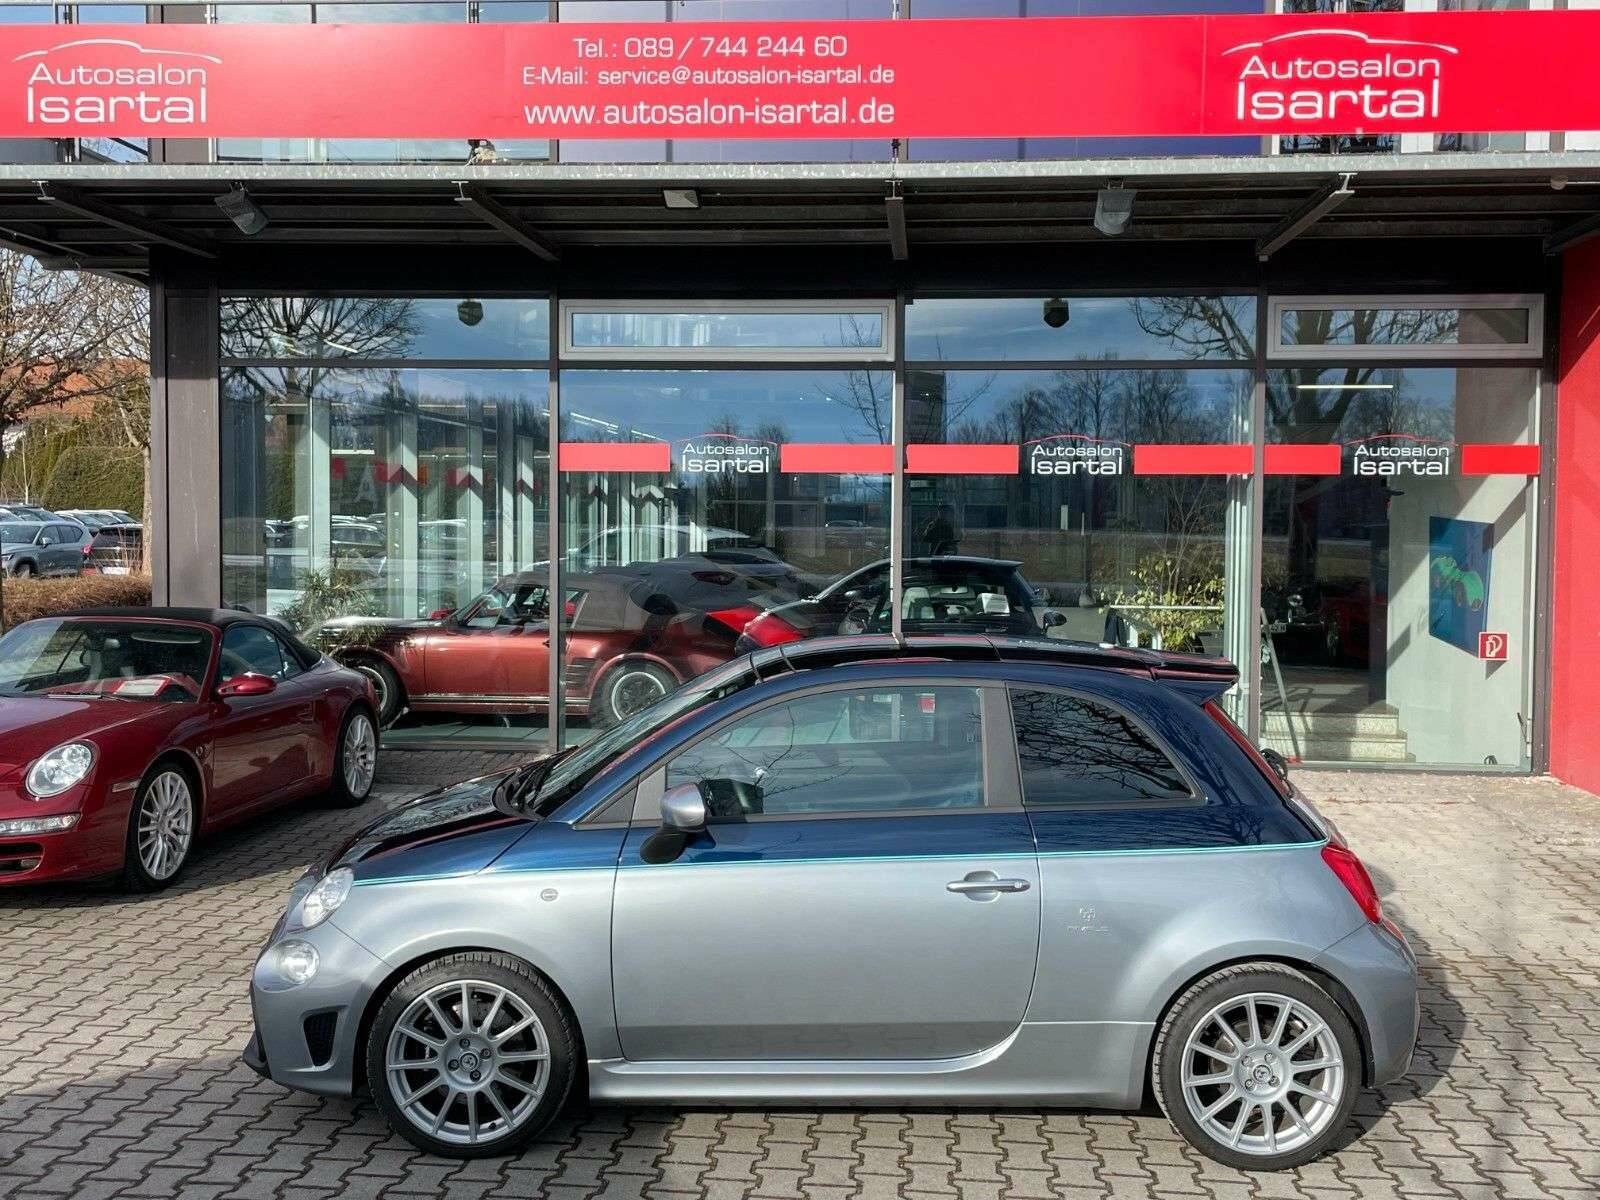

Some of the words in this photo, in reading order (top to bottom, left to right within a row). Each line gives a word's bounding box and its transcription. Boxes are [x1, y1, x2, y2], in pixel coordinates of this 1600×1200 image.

[573, 37, 618, 58] Tel.:
[624, 37, 674, 57] 089
[677, 37, 694, 60] /
[700, 37, 748, 57] 744
[757, 36, 805, 57] 244
[814, 35, 848, 57] 60
[28, 62, 207, 86] Autosalon
[522, 66, 589, 85] E-Mail:
[598, 64, 895, 85] service@autosalon-isartal.de
[1239, 53, 1441, 80] Autosalon
[27, 86, 207, 123] Isartal
[1237, 78, 1440, 120] Isartal
[524, 97, 896, 126] www.autosalon-isartal.de
[682, 443, 770, 455] Autosalon
[1031, 444, 1123, 456] Autosalon
[1354, 444, 1450, 457] Autosalon
[682, 455, 770, 473] Isartal
[1031, 457, 1123, 475] Isartal
[1353, 457, 1449, 476] Isartal
